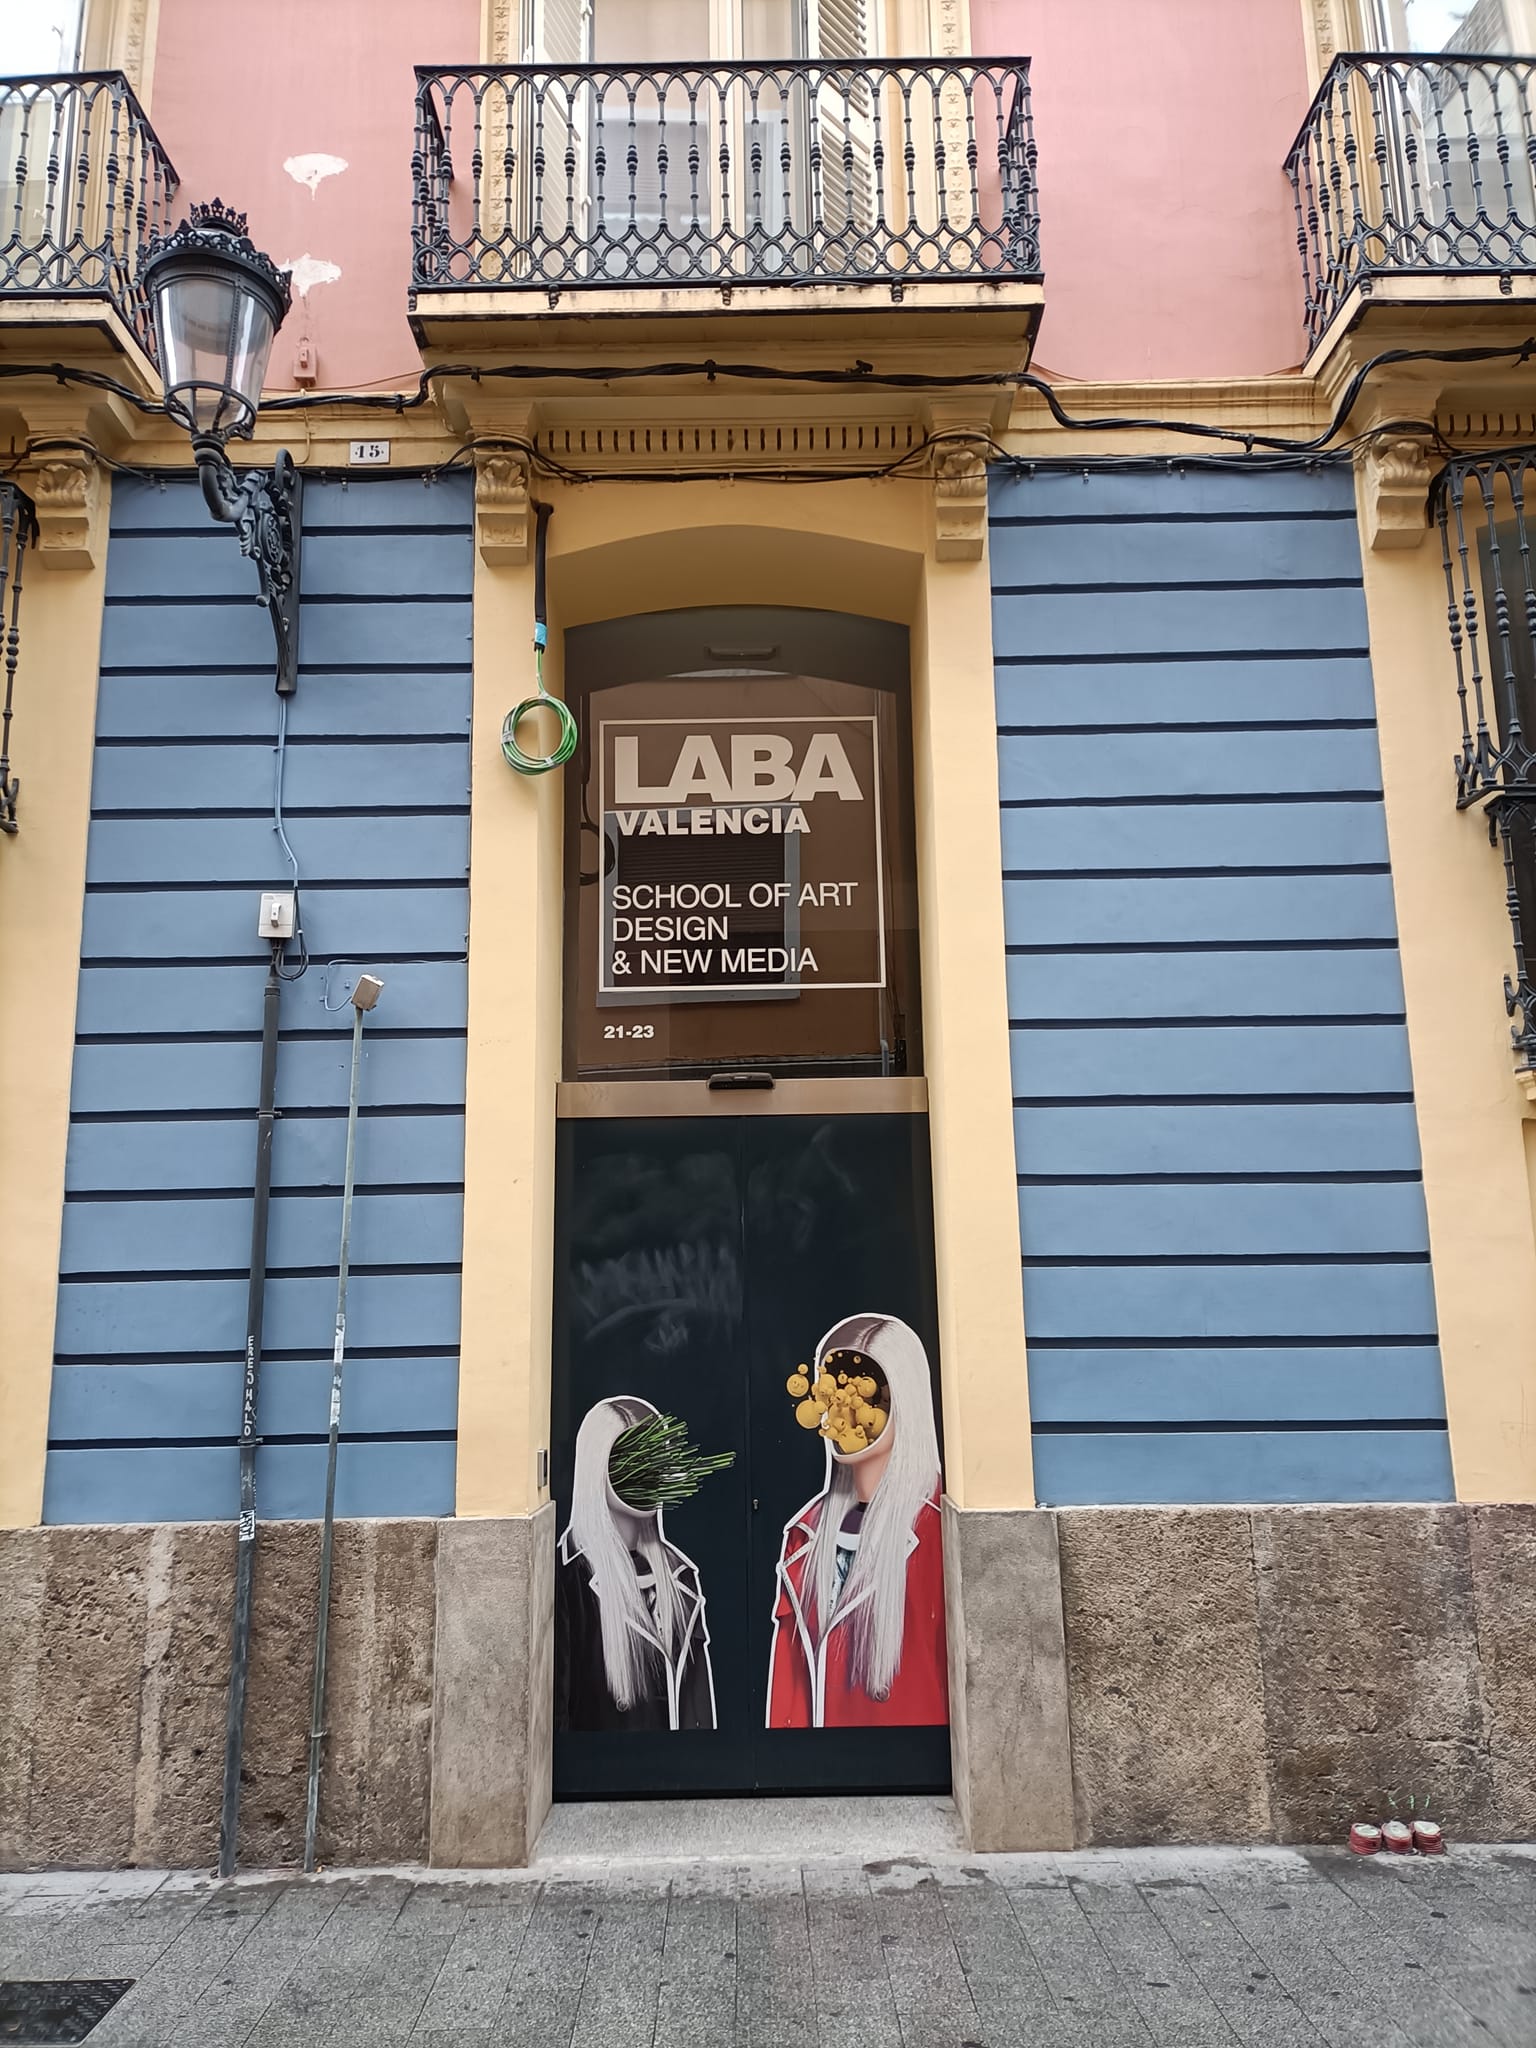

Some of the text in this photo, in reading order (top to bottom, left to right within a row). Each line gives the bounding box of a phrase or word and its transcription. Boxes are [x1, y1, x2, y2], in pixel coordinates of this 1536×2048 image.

[615, 733, 864, 803] LABA
[616, 807, 811, 836] VALENCIA
[612, 882, 859, 910] SCHOOL OF ART
[612, 916, 728, 942] DESIGN
[611, 947, 819, 975] & NEW MEDIA
[604, 1025, 655, 1039] 21-23
